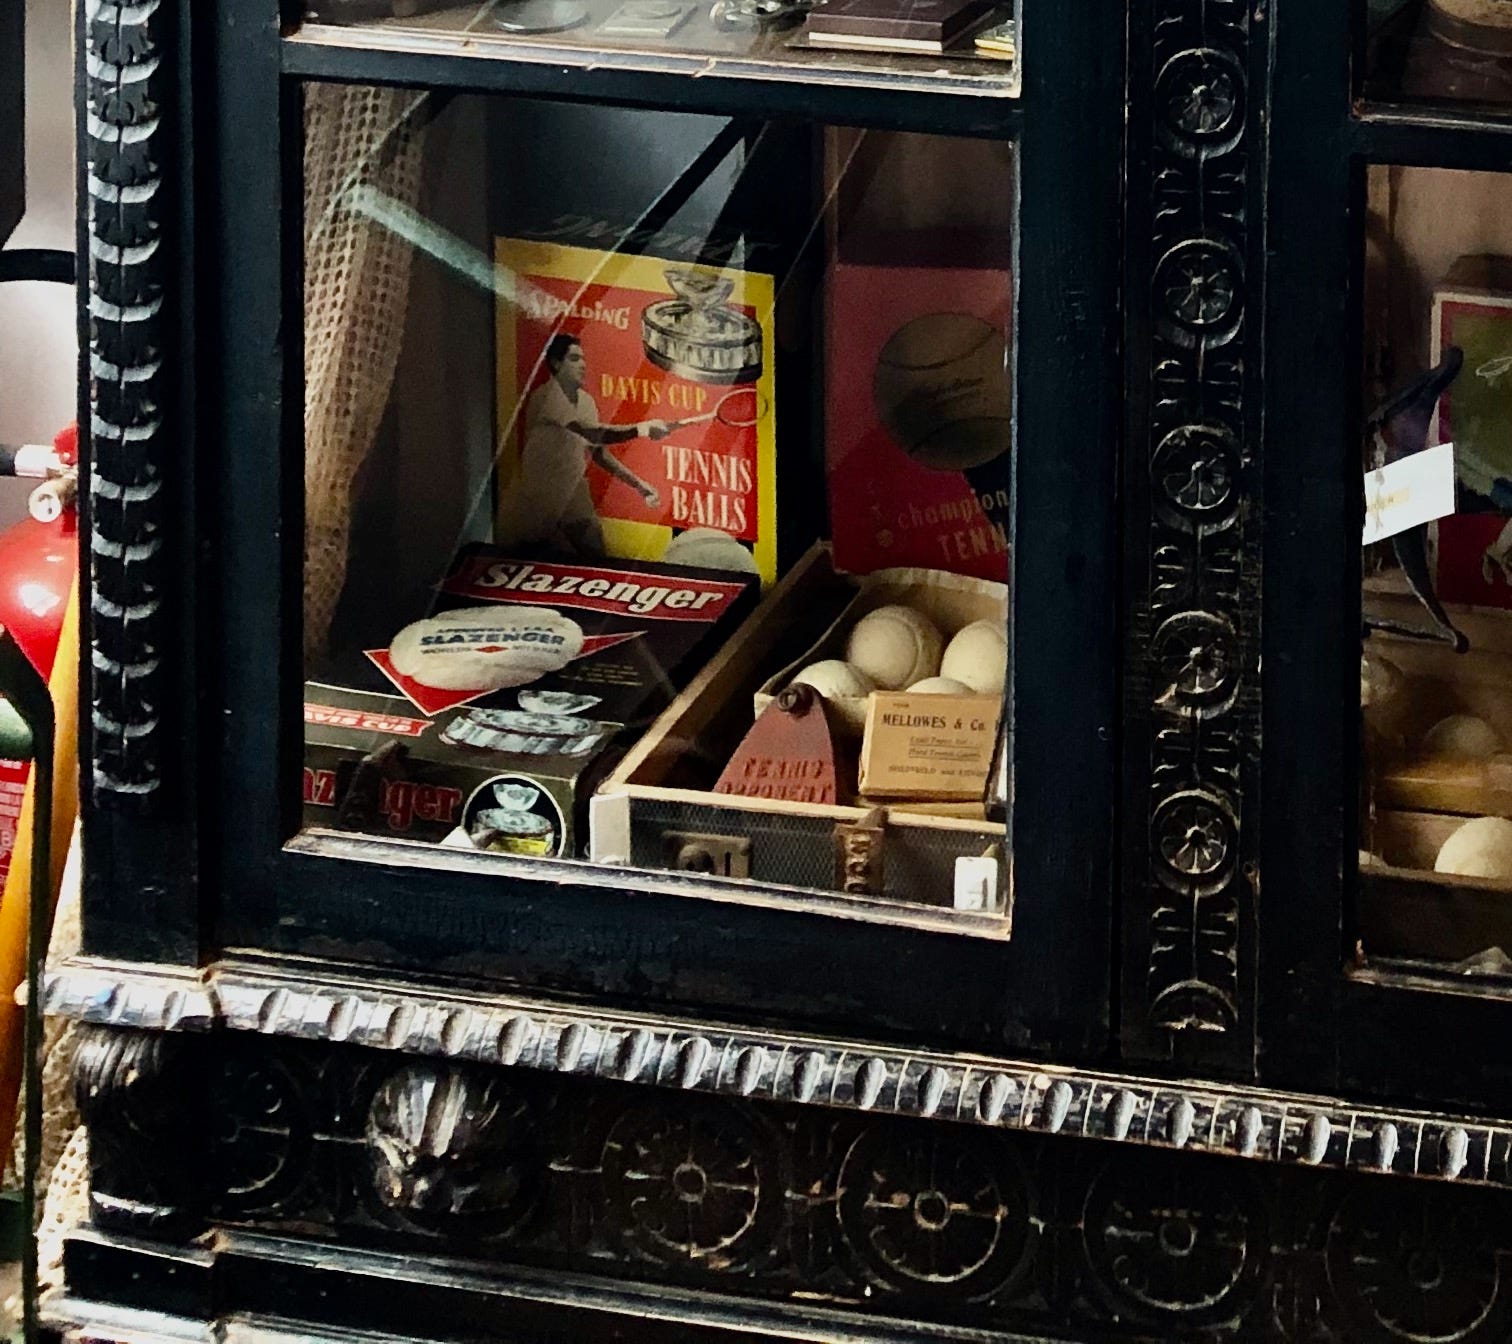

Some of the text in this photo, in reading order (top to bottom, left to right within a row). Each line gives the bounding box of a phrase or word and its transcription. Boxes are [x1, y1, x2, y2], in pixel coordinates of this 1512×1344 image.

[600, 373, 708, 413] DAVIS CUP
[662, 444, 752, 495] TENNIS
[672, 485, 747, 533] BALLS
[475, 563, 725, 613] Slazenger
[420, 632, 565, 646] SLAZENGER
[304, 710, 358, 727] AVIS
[362, 718, 412, 734] CUP
[882, 713, 947, 729] MELLOWES
[953, 718, 962, 730] &
